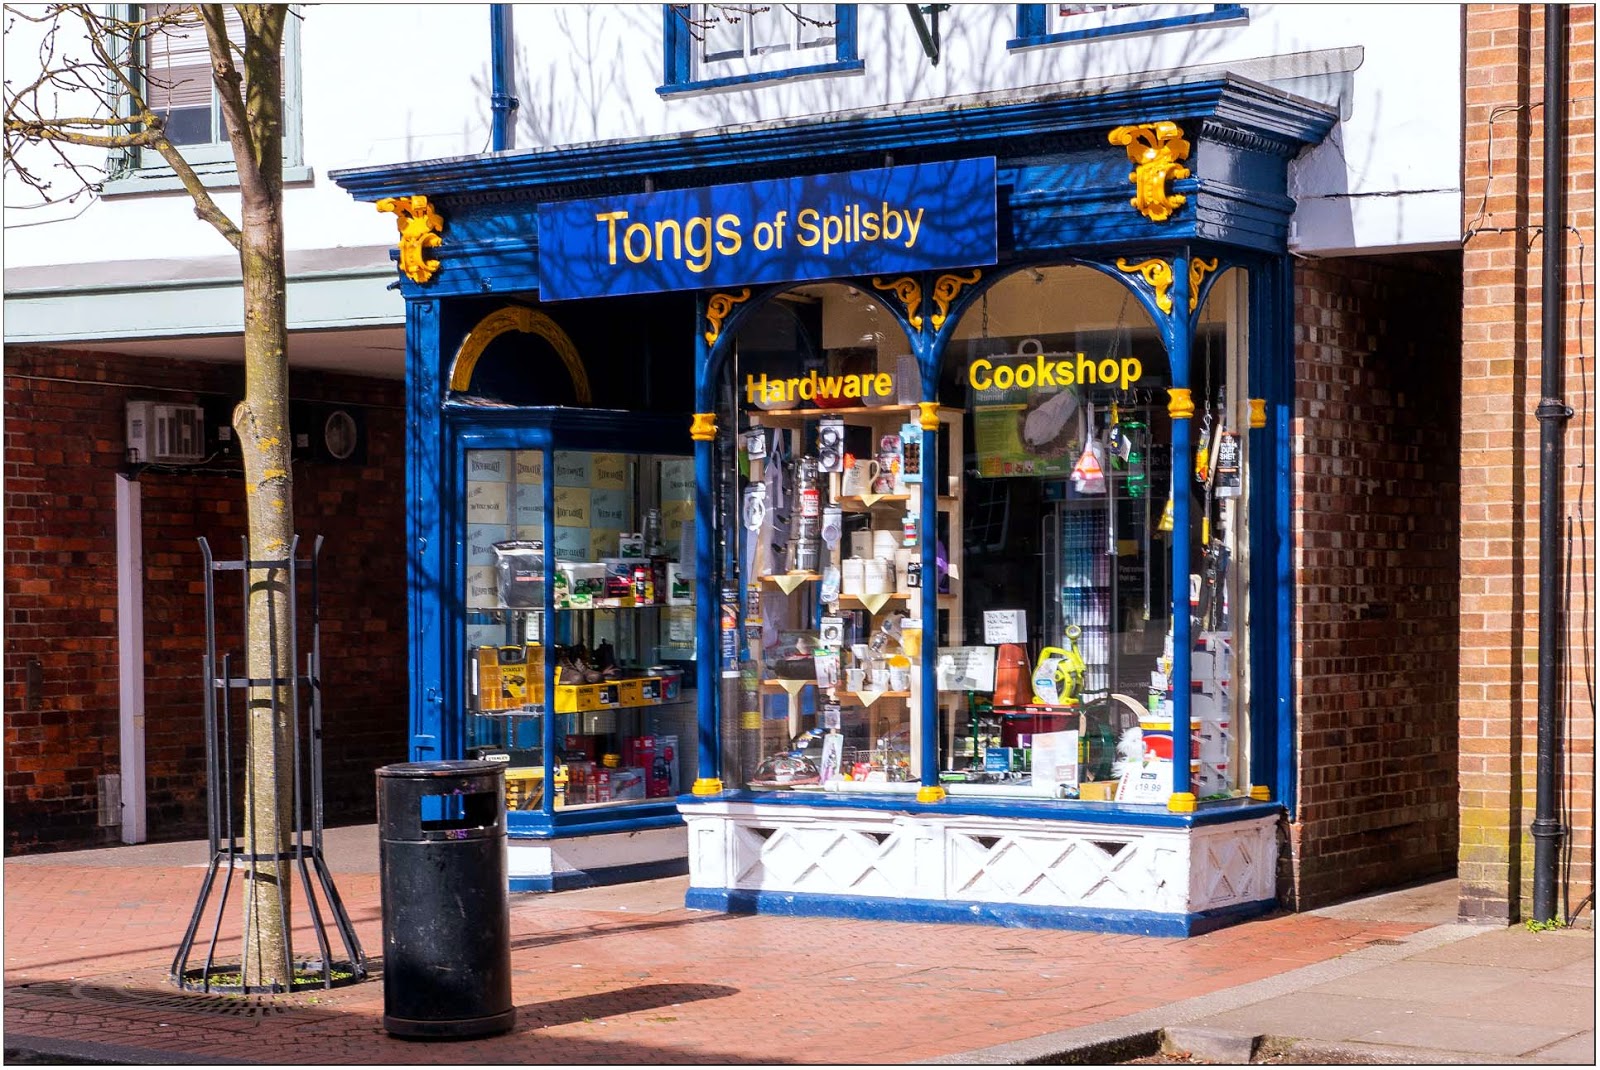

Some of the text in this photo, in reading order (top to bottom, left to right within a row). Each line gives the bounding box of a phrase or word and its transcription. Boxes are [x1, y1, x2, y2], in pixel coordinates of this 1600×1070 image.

[596, 202, 925, 273] Tongs of Spilsby
[746, 370, 893, 404] Hardware
[969, 353, 1142, 390] Cookshop
